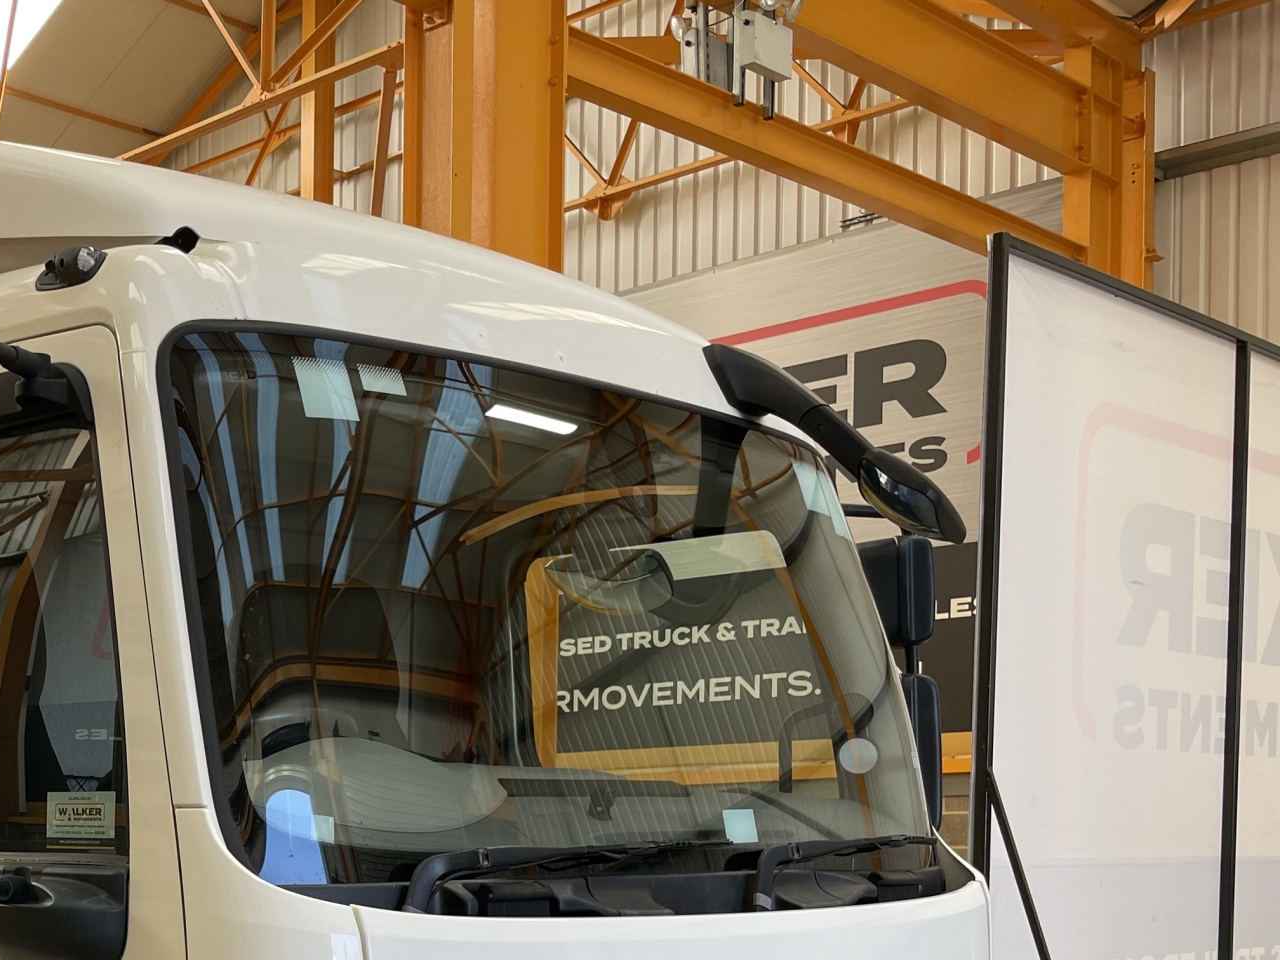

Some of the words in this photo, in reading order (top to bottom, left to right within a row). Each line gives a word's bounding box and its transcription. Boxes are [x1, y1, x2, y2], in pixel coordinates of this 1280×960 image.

[559, 635, 612, 657] SED
[616, 624, 711, 651] TRUCK
[716, 622, 736, 642] &
[58, 807, 102, 822] WALKER
